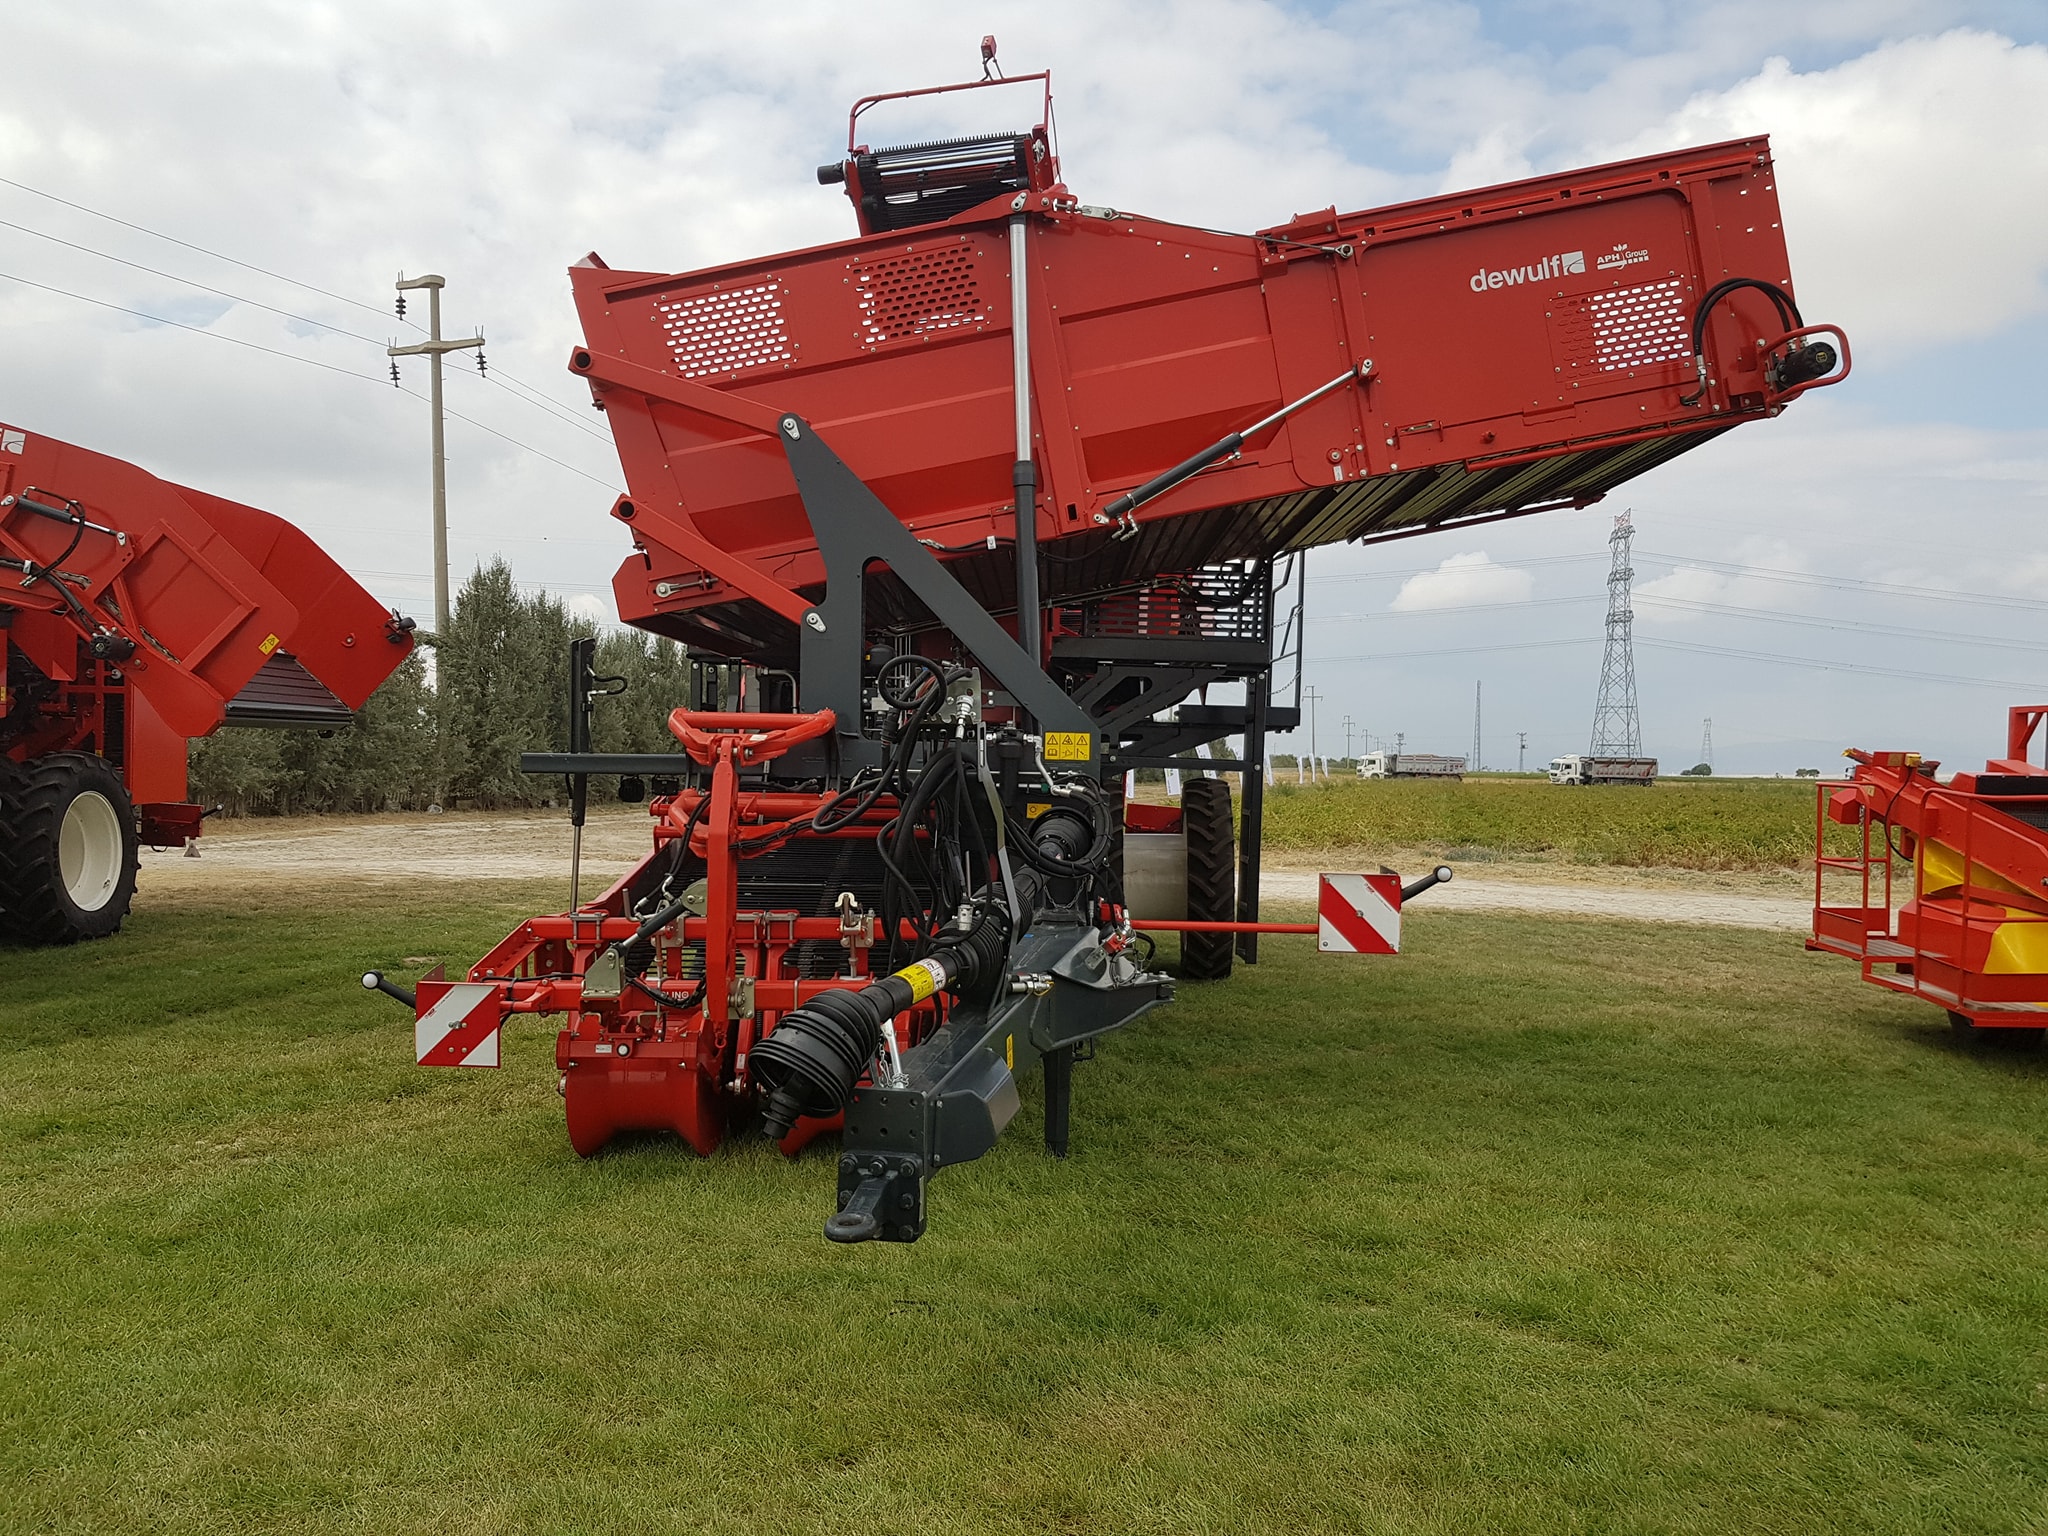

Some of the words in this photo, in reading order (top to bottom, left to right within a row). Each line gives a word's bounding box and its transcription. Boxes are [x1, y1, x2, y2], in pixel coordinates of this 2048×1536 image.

[1597, 253, 1620, 265] APH
[1625, 249, 1648, 259] Group
[1470, 255, 1560, 292] dewulf
